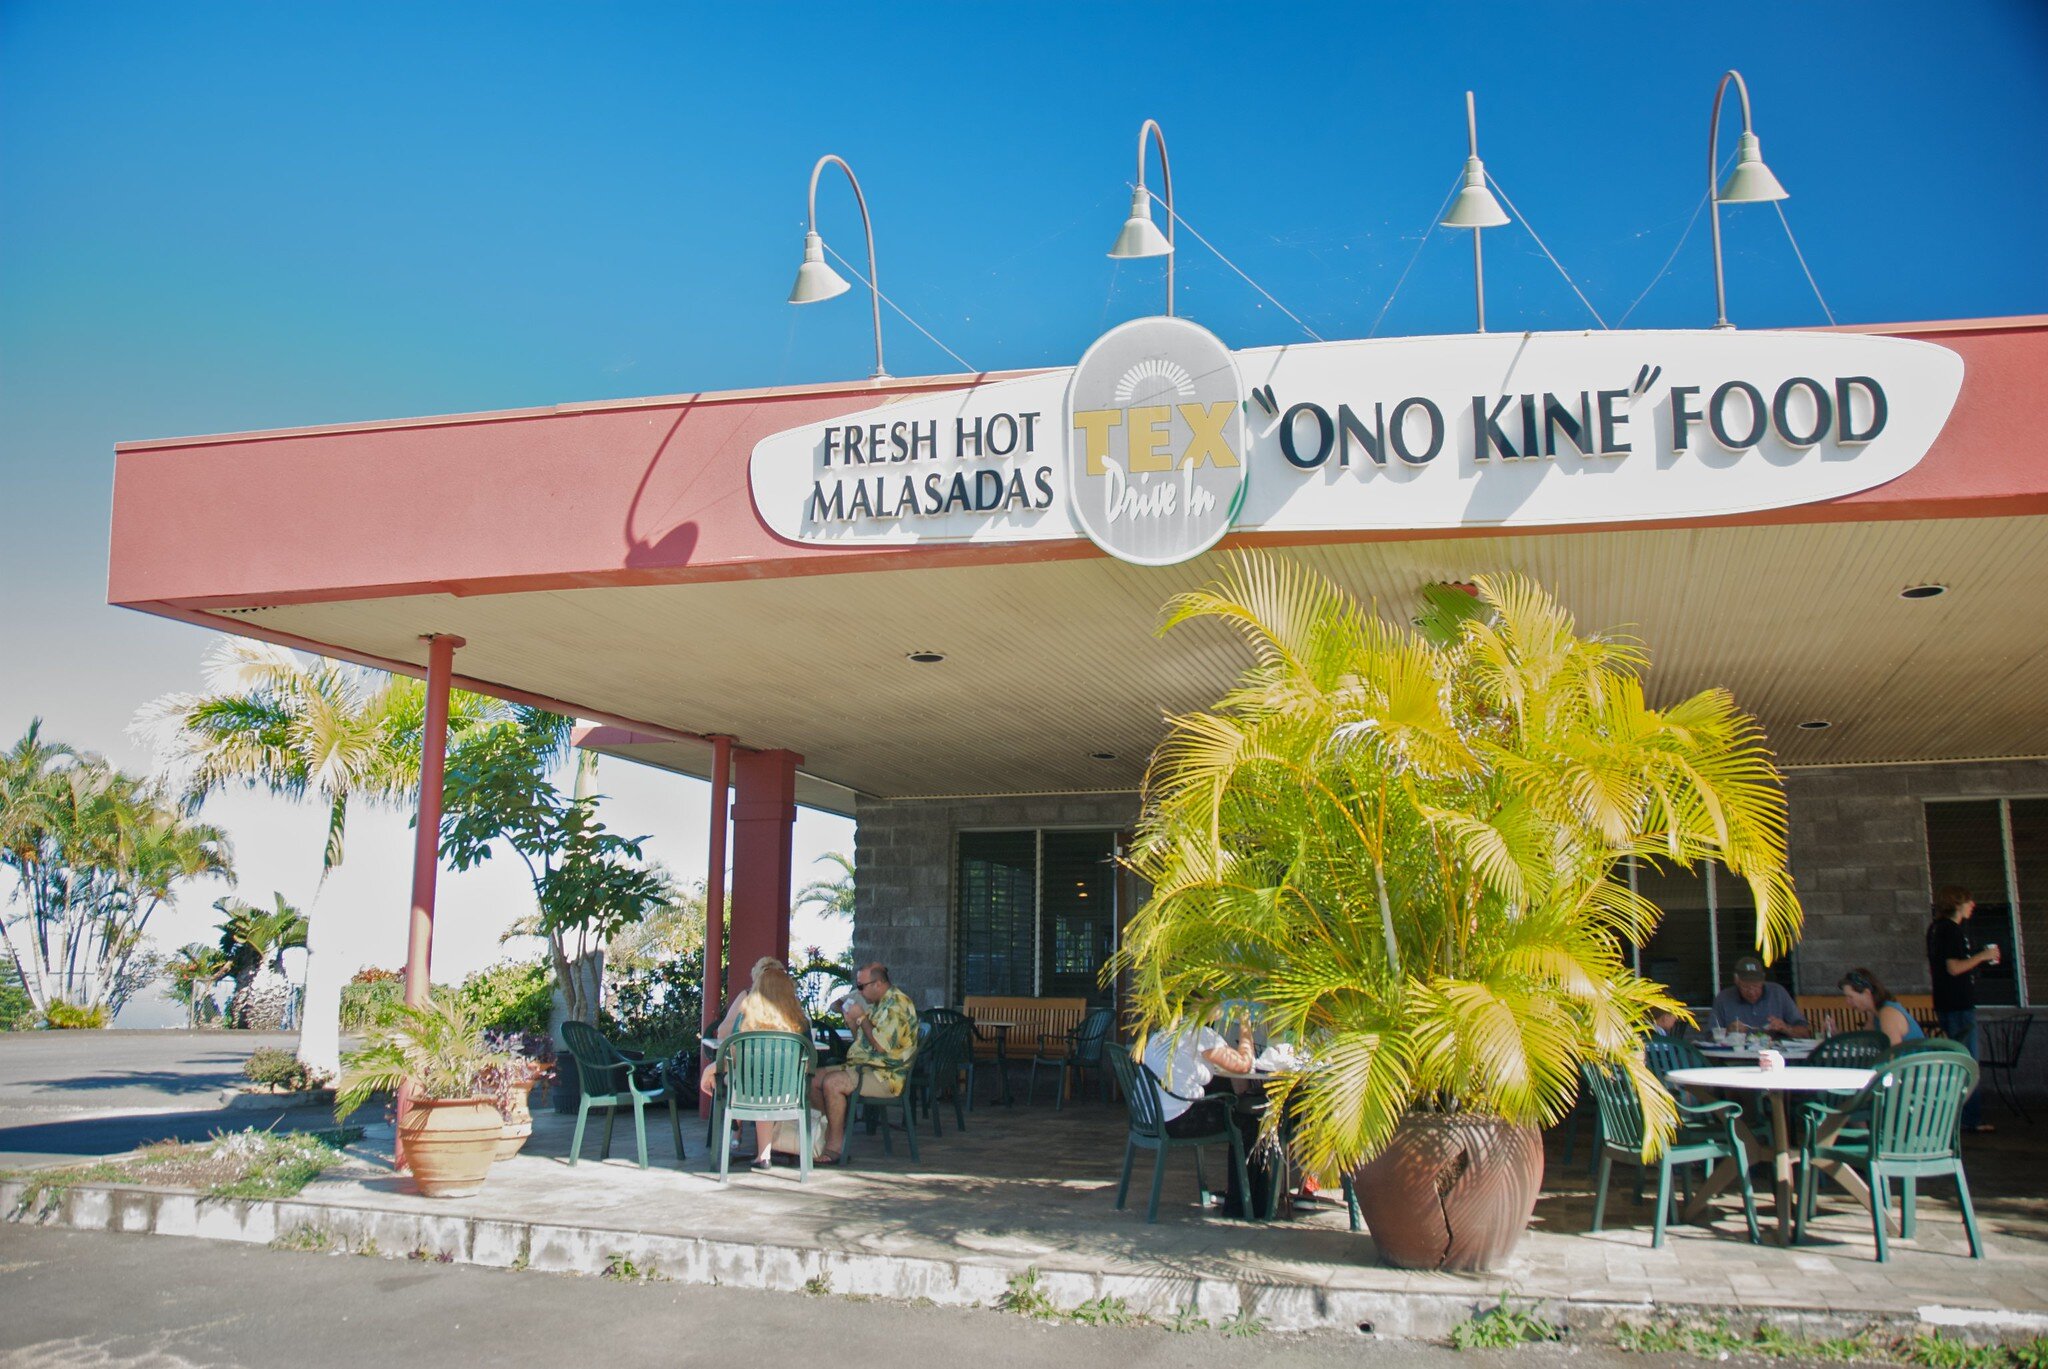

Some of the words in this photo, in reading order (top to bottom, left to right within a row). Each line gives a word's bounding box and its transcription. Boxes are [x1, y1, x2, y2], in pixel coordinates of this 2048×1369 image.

[823, 419, 937, 467] FRESH
[956, 411, 1041, 459] HOT
[1073, 401, 1240, 476] TEX
[1671, 375, 1889, 454] FOOD
[810, 465, 1055, 522] MALASADAS
[1101, 455, 1177, 524] Drive
[1183, 457, 1216, 517] In
